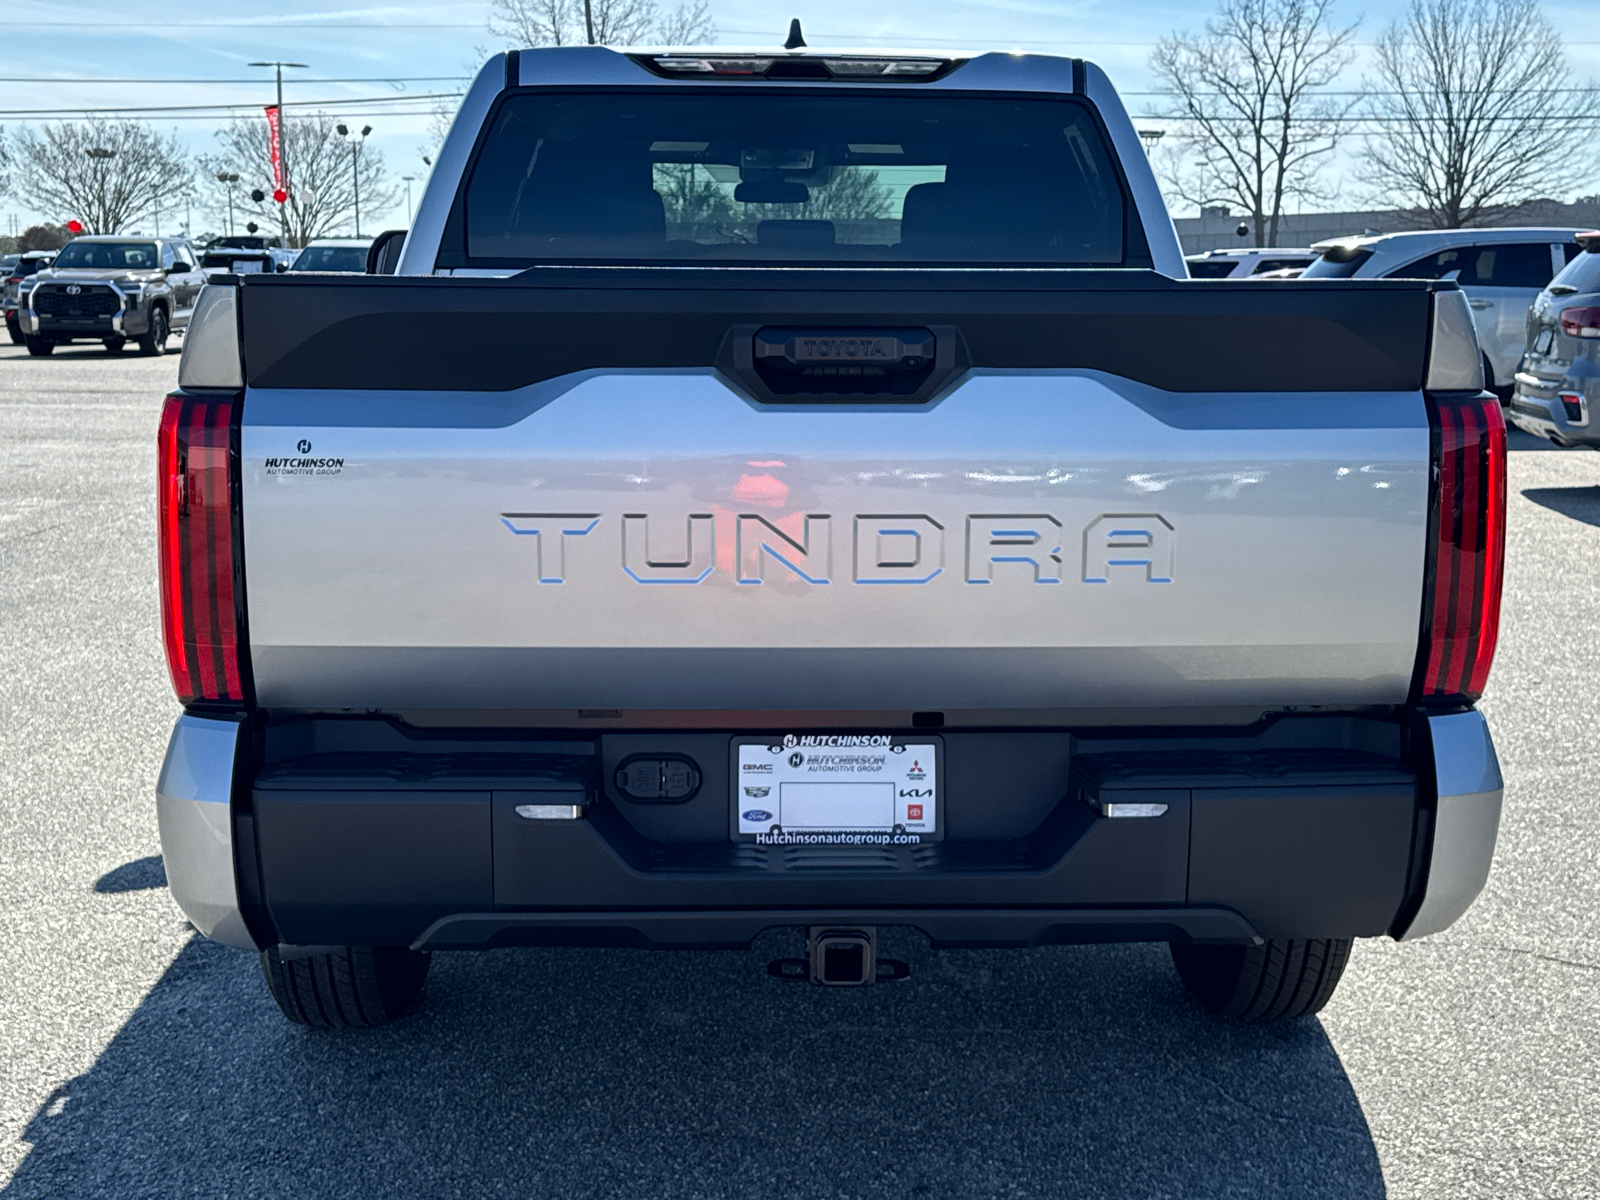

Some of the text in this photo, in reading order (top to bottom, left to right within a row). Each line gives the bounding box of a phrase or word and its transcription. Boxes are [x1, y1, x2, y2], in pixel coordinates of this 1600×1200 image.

[804, 340, 886, 356] TOYOTA
[265, 458, 344, 468] HUTCHINSON
[499, 513, 1176, 584] TUNDRA
[800, 735, 891, 747] HUTCHINSON
[807, 755, 885, 765] HUTCHINSON
[756, 833, 920, 845] Hutchinsonautogroup.com
